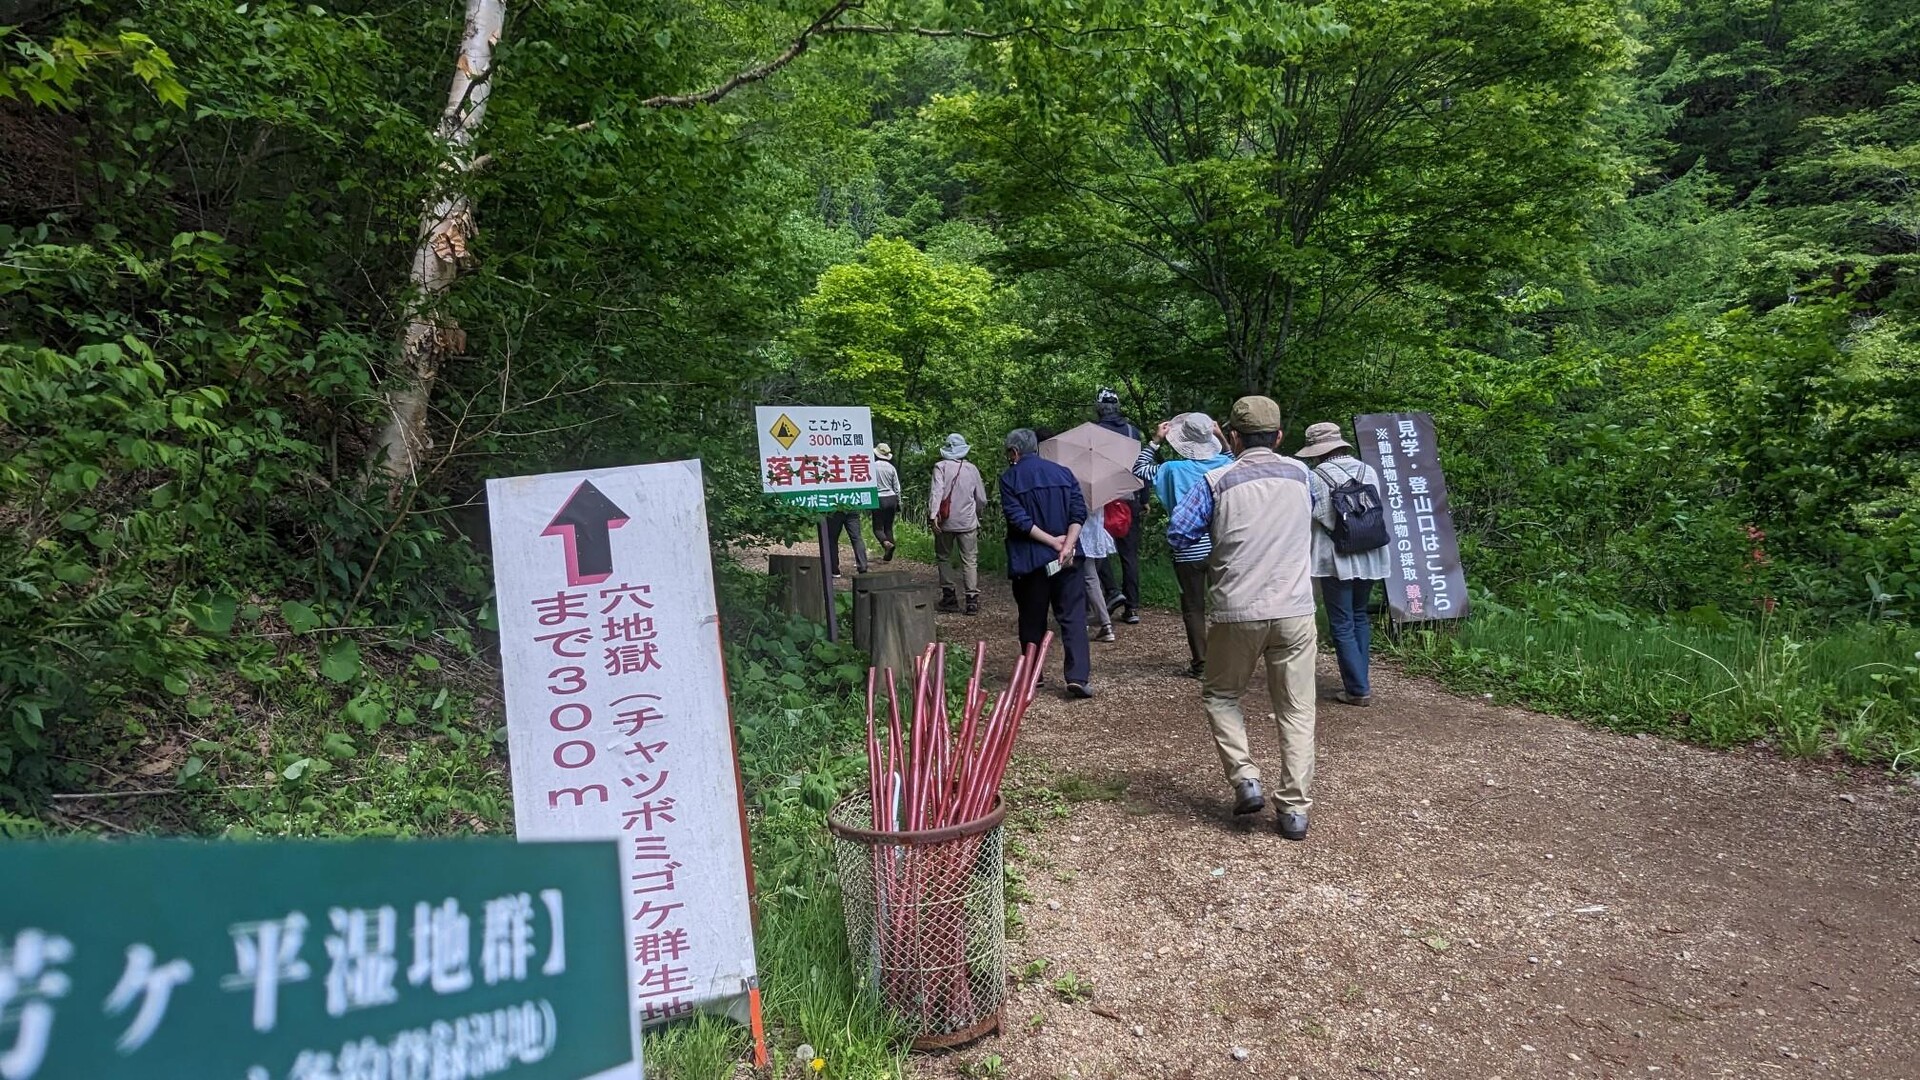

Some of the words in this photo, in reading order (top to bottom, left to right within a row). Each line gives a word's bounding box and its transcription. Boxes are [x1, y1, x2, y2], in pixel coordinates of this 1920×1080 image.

[808, 419, 852, 431] ここから
[808, 433, 864, 446] 300m区間
[766, 454, 872, 486] 落石注意
[776, 491, 872, 508] ツボミゴケ公園
[1398, 420, 1451, 611] 見学・登山口はこちら
[531, 591, 609, 809] まで300m
